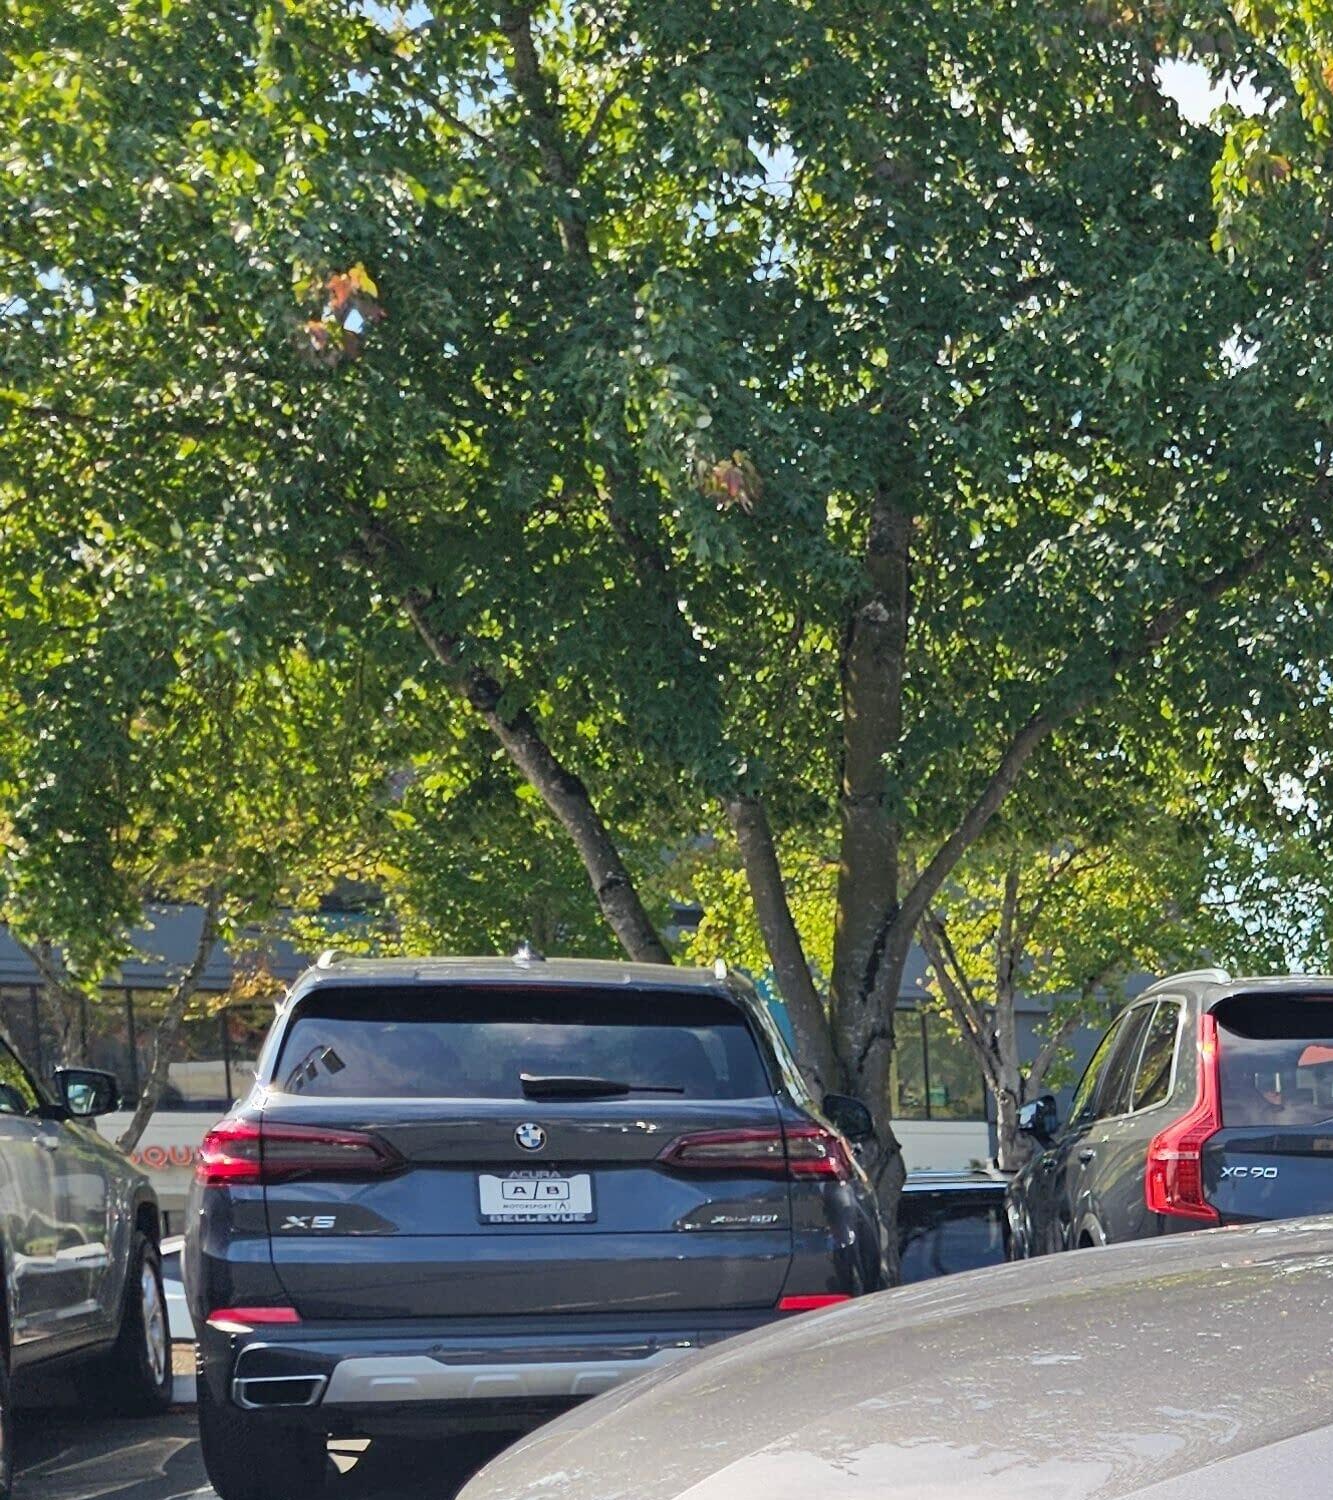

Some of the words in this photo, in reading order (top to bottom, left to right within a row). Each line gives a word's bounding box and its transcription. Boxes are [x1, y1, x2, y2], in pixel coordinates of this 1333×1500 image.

[130, 1145, 201, 1168] QU
[513, 1186, 527, 1195] A
[546, 1187, 560, 1195] B
[281, 1215, 336, 1229] X5
[490, 1214, 586, 1222] BELLEVUE
